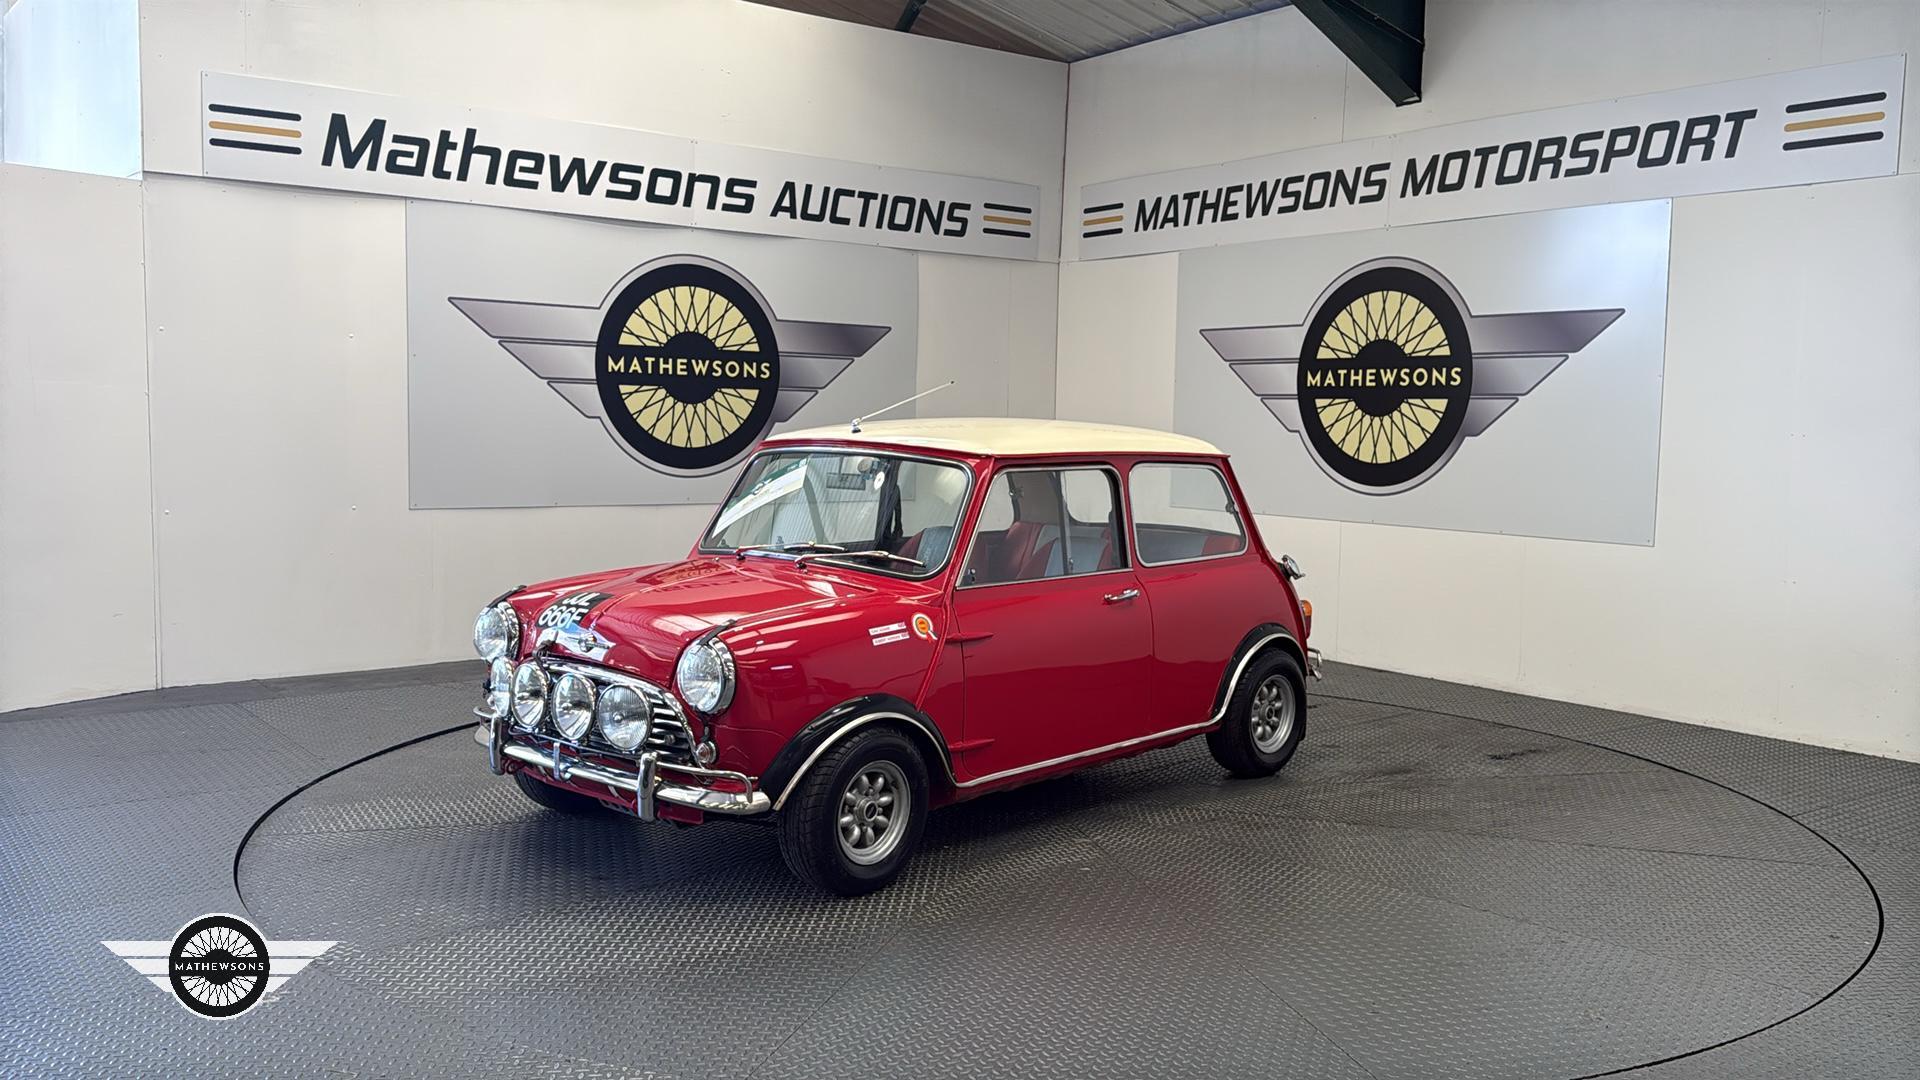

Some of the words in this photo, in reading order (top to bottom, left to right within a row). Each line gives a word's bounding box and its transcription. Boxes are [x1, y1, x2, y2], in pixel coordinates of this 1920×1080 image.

[321, 113, 758, 214] Mathewsons
[770, 180, 972, 238] AUCTIONS
[1133, 161, 1392, 233] MATHEWSONS
[1399, 108, 1758, 199] MOTORSPORT
[607, 355, 771, 379] MATHEWSONS
[1306, 367, 1463, 387] MATHEWSONS
[538, 604, 589, 629] 666F
